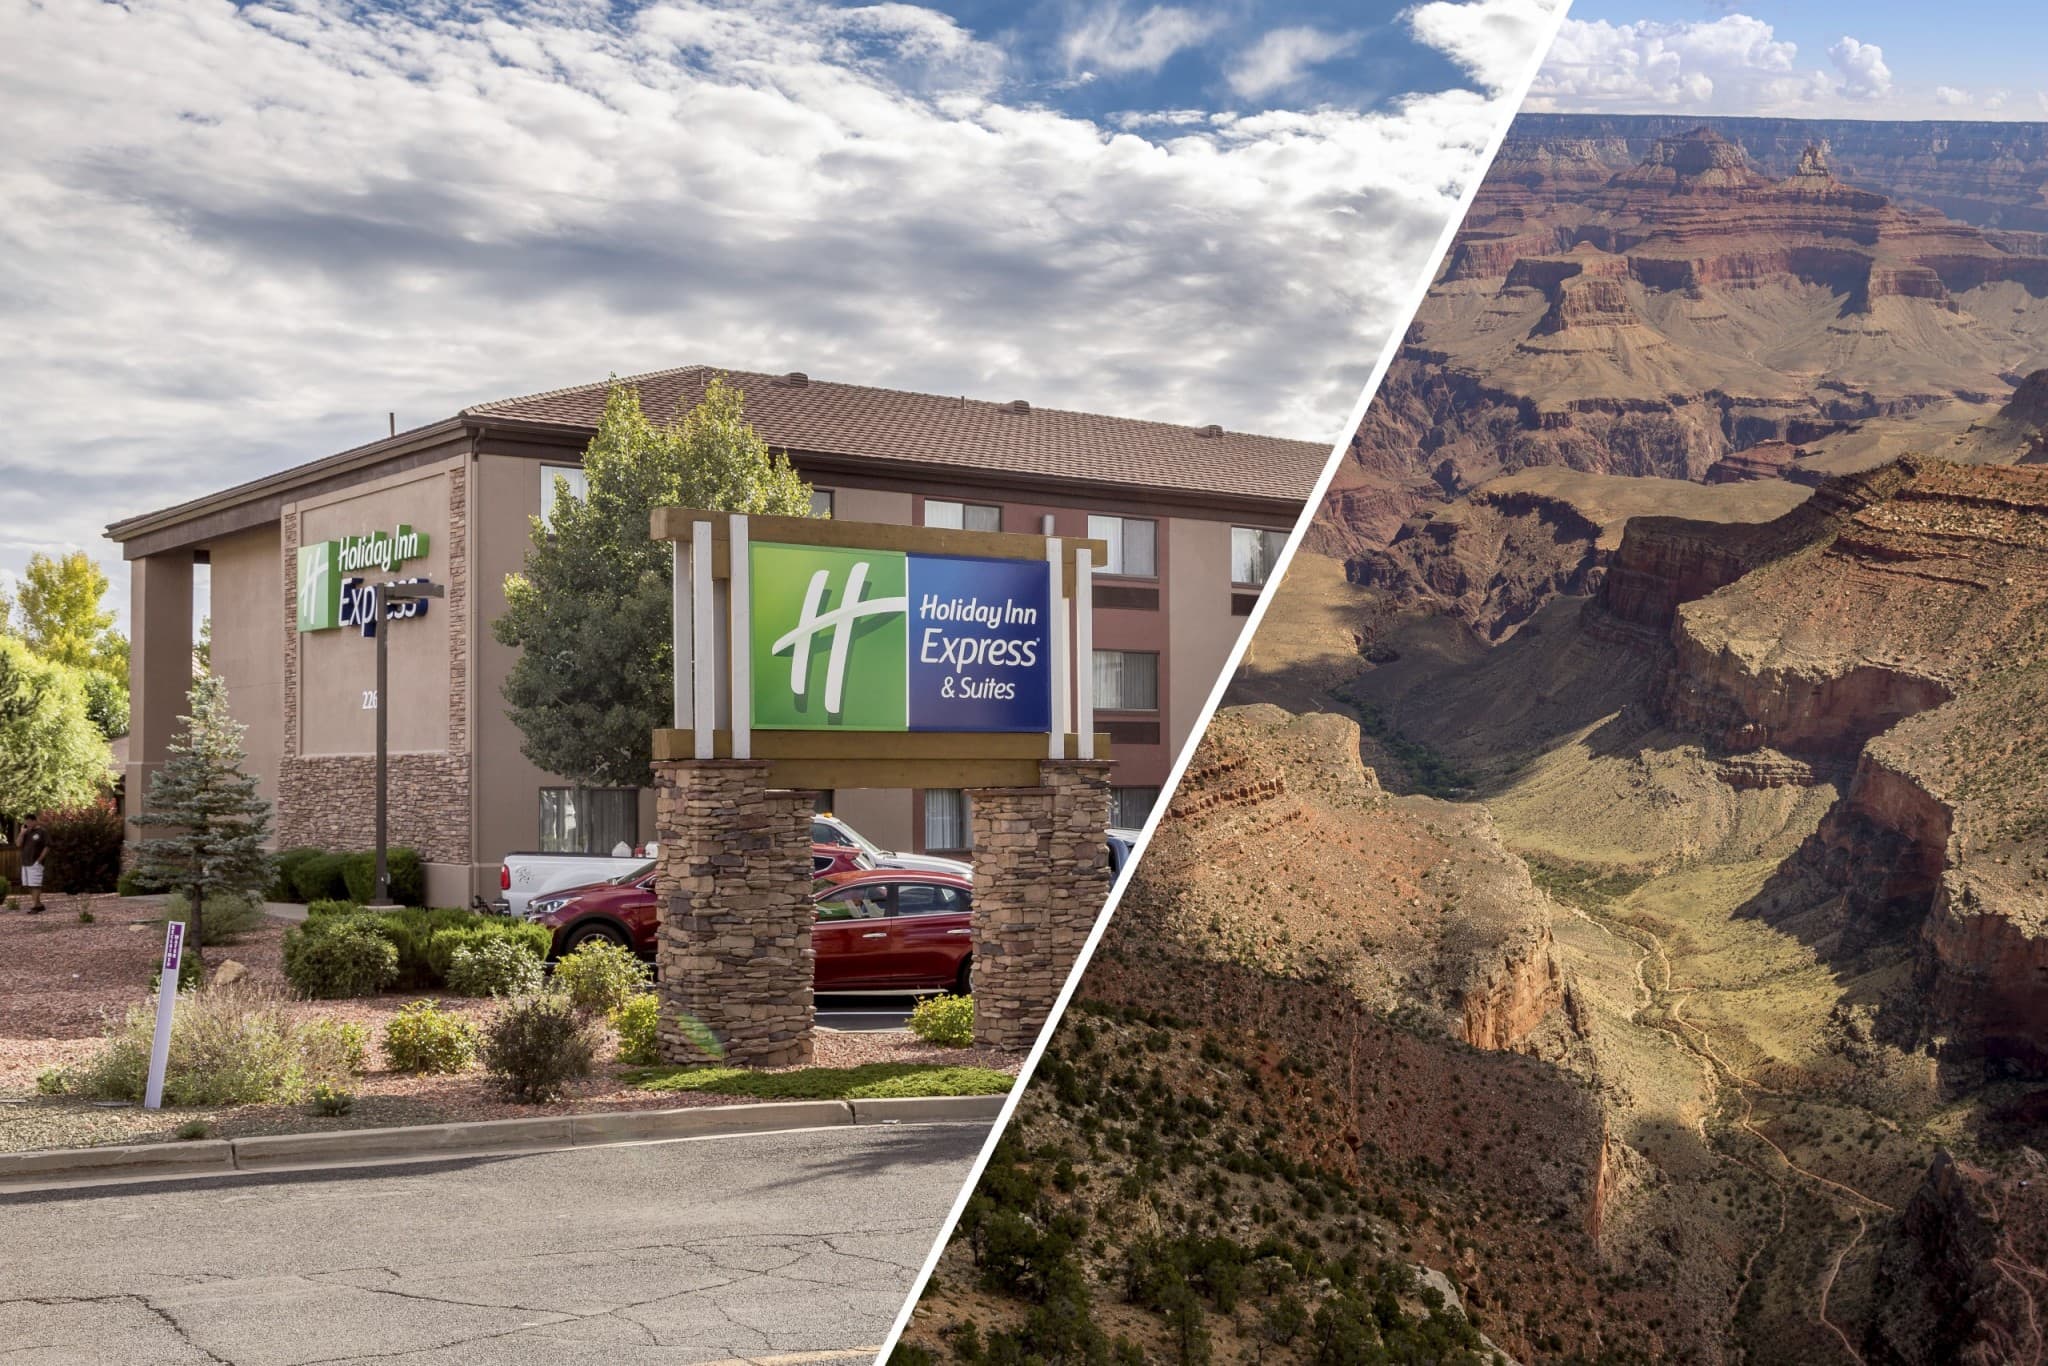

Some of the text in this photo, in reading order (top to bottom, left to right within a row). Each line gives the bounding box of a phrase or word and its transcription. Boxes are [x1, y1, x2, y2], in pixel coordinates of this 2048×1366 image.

[338, 524, 418, 572] Holiday Inn
[920, 593, 1037, 630] Holiday Inn
[920, 627, 1038, 674] Express
[941, 676, 1016, 700] & Suites
